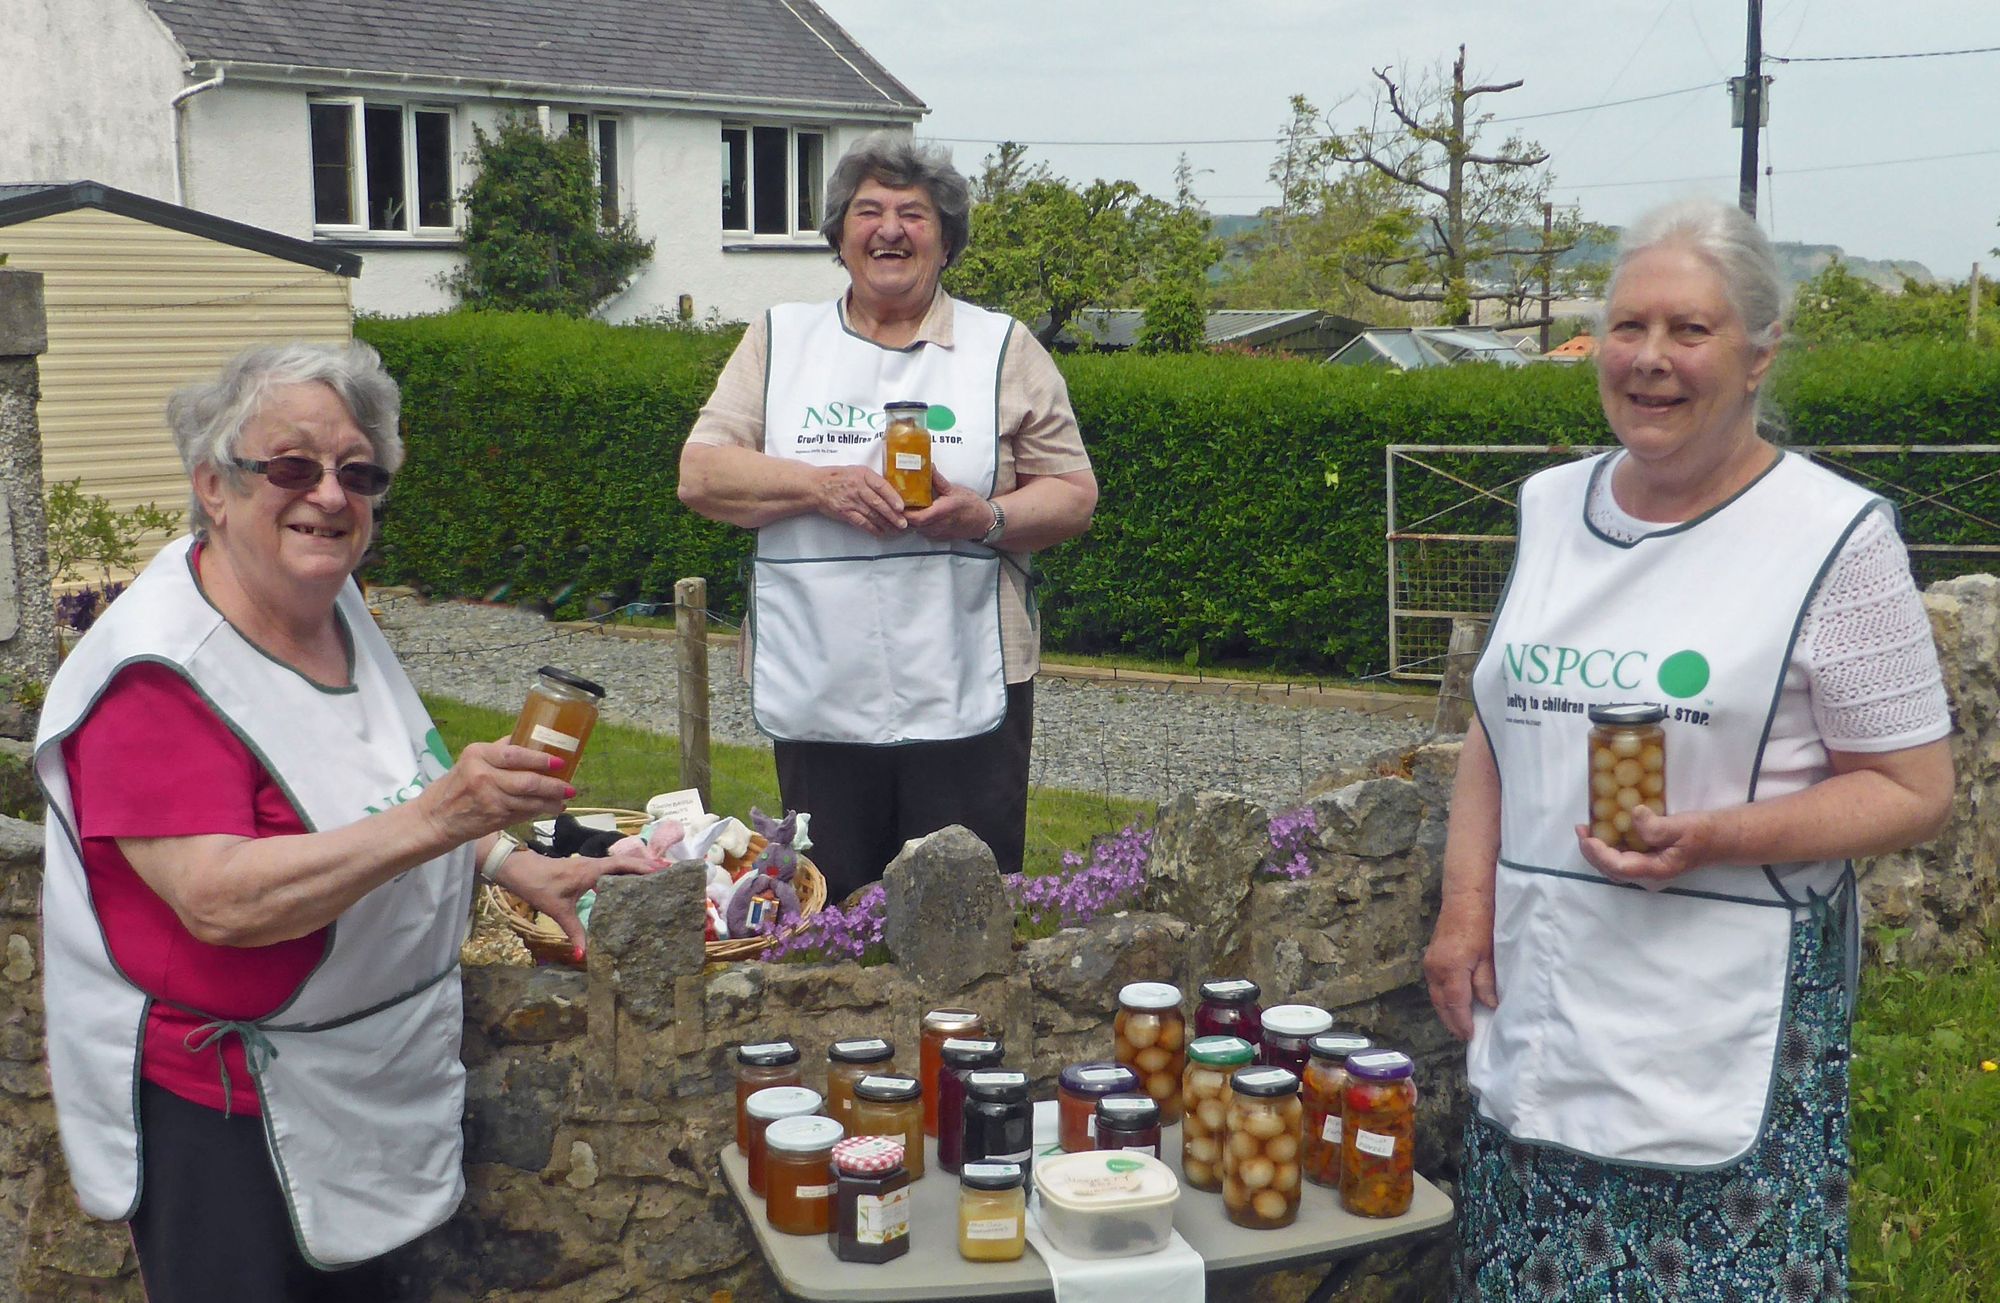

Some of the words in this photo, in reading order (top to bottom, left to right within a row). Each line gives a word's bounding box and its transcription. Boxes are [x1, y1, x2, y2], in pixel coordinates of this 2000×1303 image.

[802, 401, 886, 429] NSPC
[827, 432, 836, 443] to
[940, 436, 963, 445] STOP.
[1503, 643, 1648, 690] NSPCC
[1530, 696, 1539, 710] to
[1542, 697, 1584, 714] children
[1674, 707, 1709, 725] STOP.
